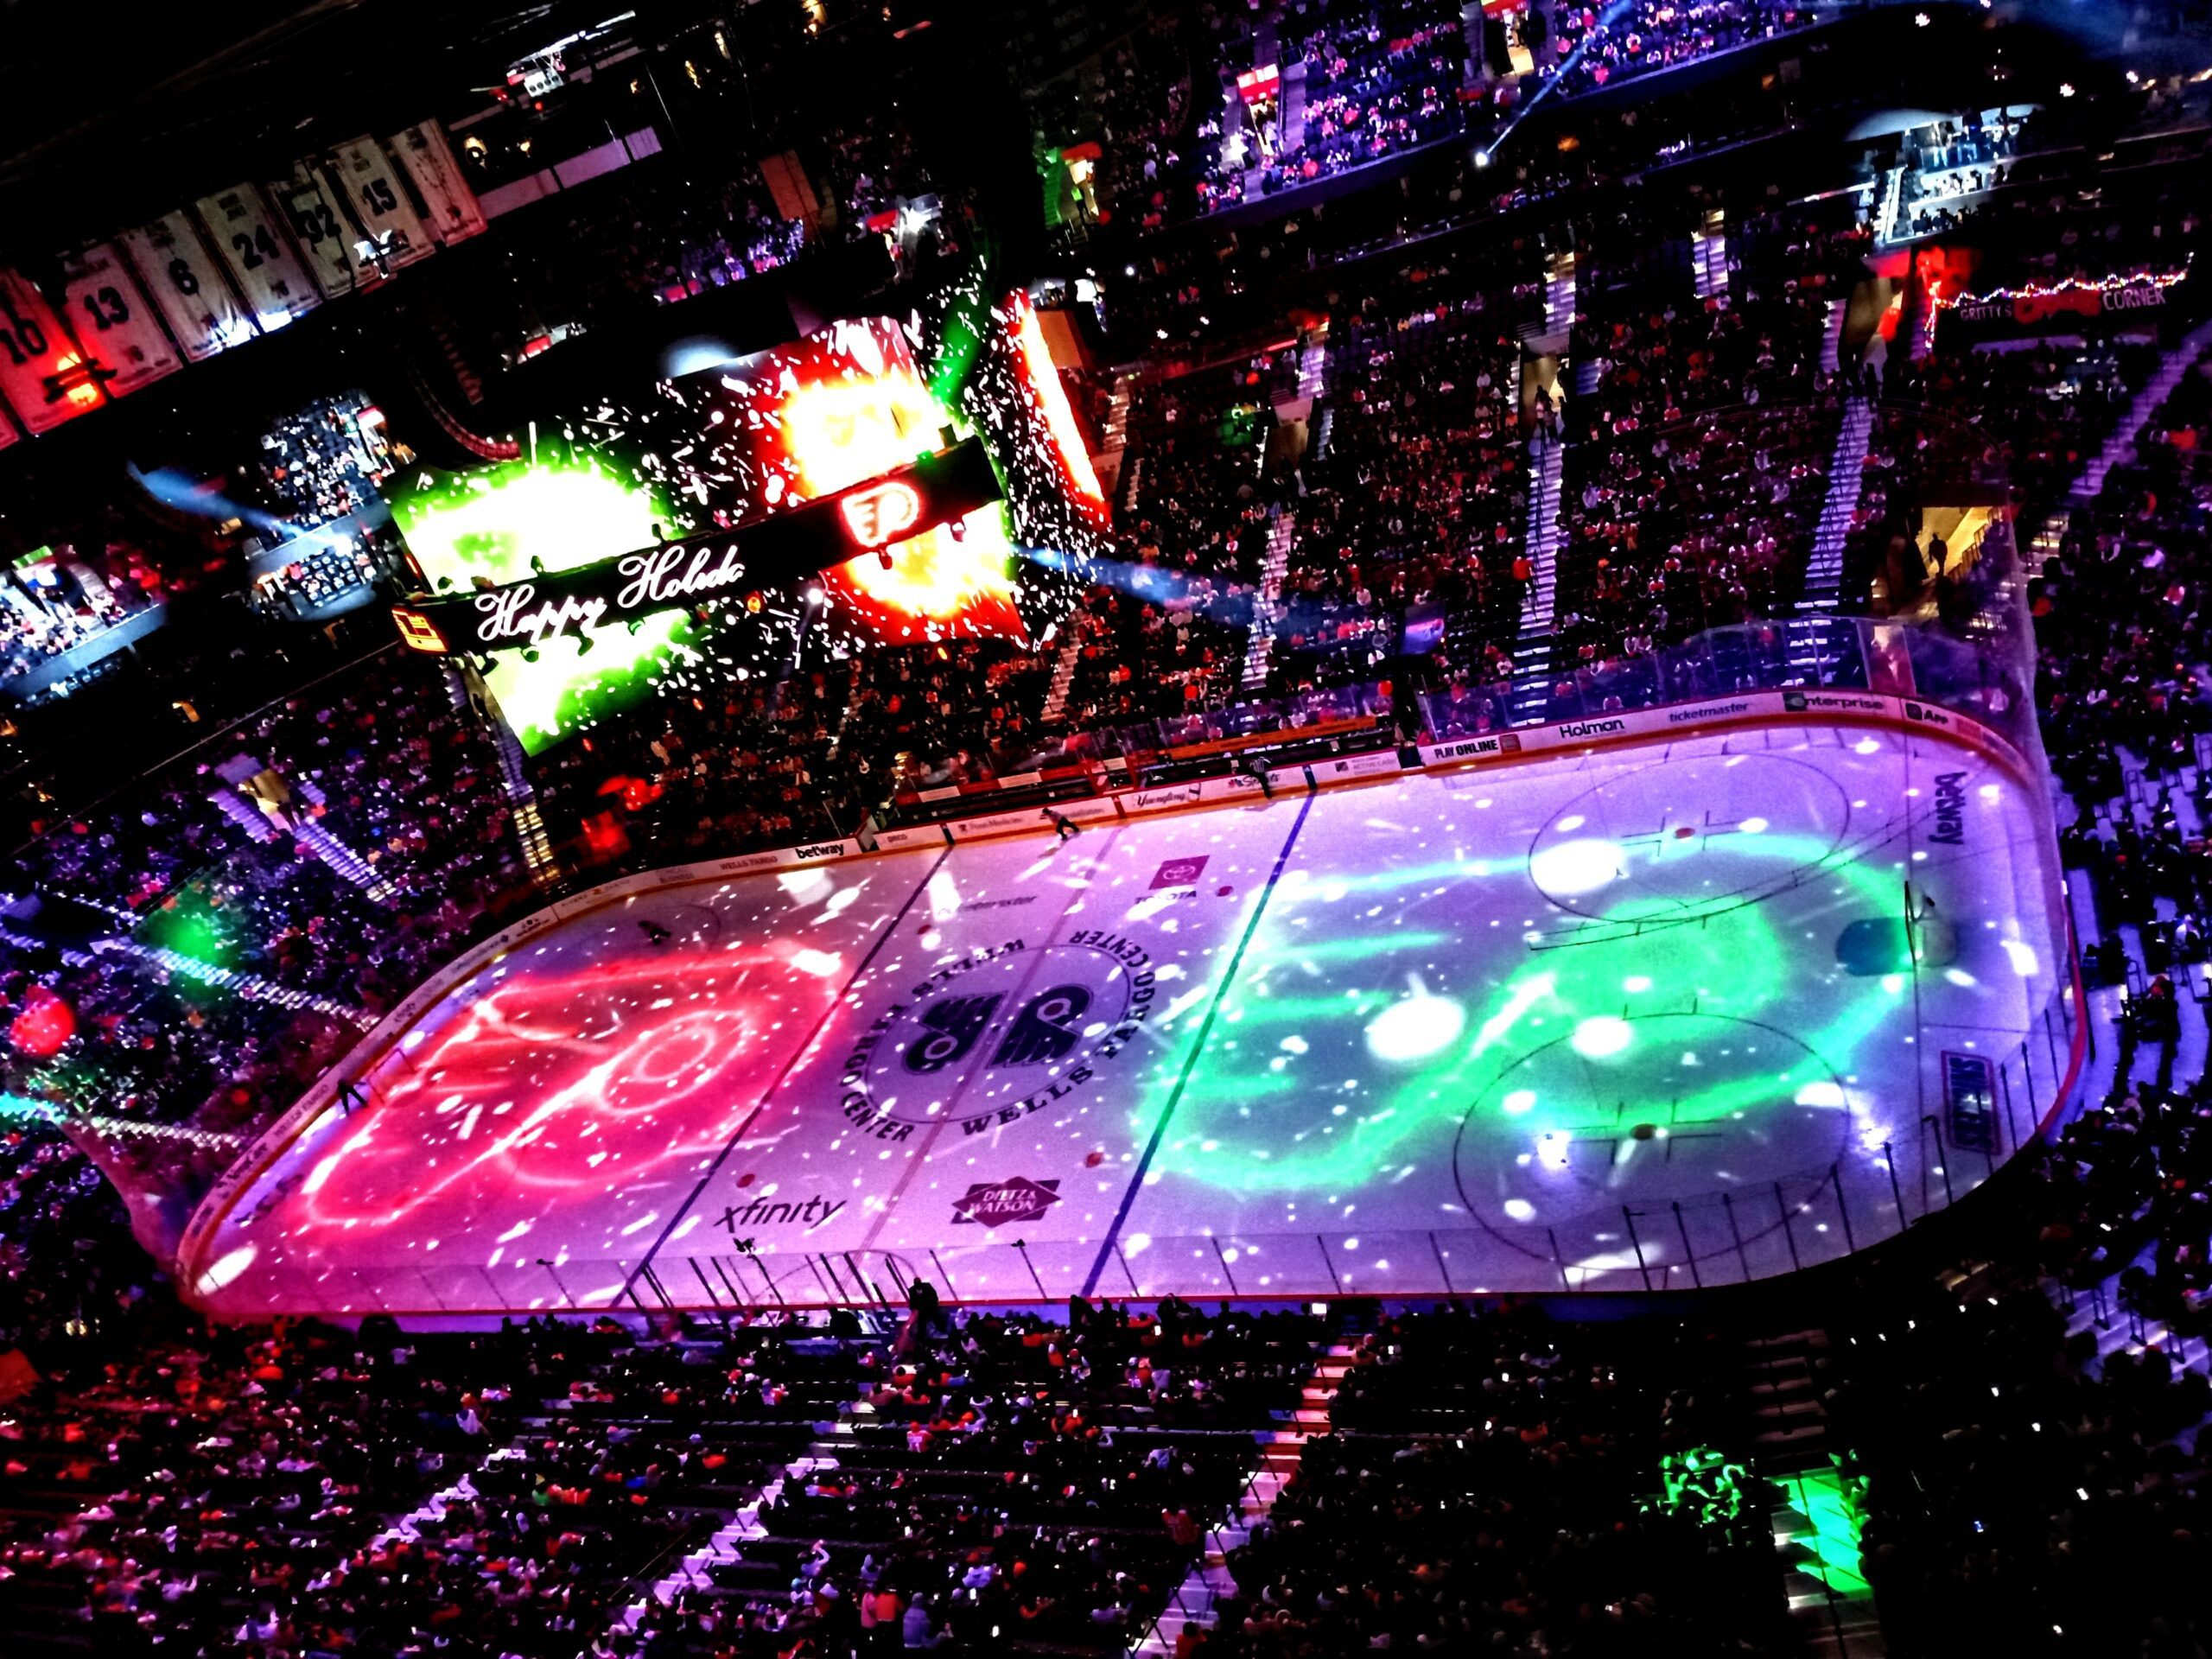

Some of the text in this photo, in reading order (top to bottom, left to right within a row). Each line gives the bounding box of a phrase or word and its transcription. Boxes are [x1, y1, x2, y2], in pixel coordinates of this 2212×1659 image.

[361, 177, 397, 216] 15
[232, 224, 281, 270] 24
[168, 258, 199, 296] 6
[84, 286, 129, 331] 13
[2101, 287, 2166, 311] CORNER
[474, 583, 607, 646] Happy
[1559, 719, 1625, 738] Holman
[1669, 702, 1750, 722] ticketmaster
[1434, 740, 1499, 759] PLAY ONLINE
[1929, 772, 1967, 845] betway
[795, 843, 844, 859] betway
[1135, 890, 1198, 904] TOTA
[961, 1065, 1094, 1135] WELLS
[1069, 930, 1149, 968] CENTER
[841, 1091, 915, 1141] CENTER
[713, 1194, 848, 1234] xfinity
[968, 1199, 1037, 1214] WATSON
